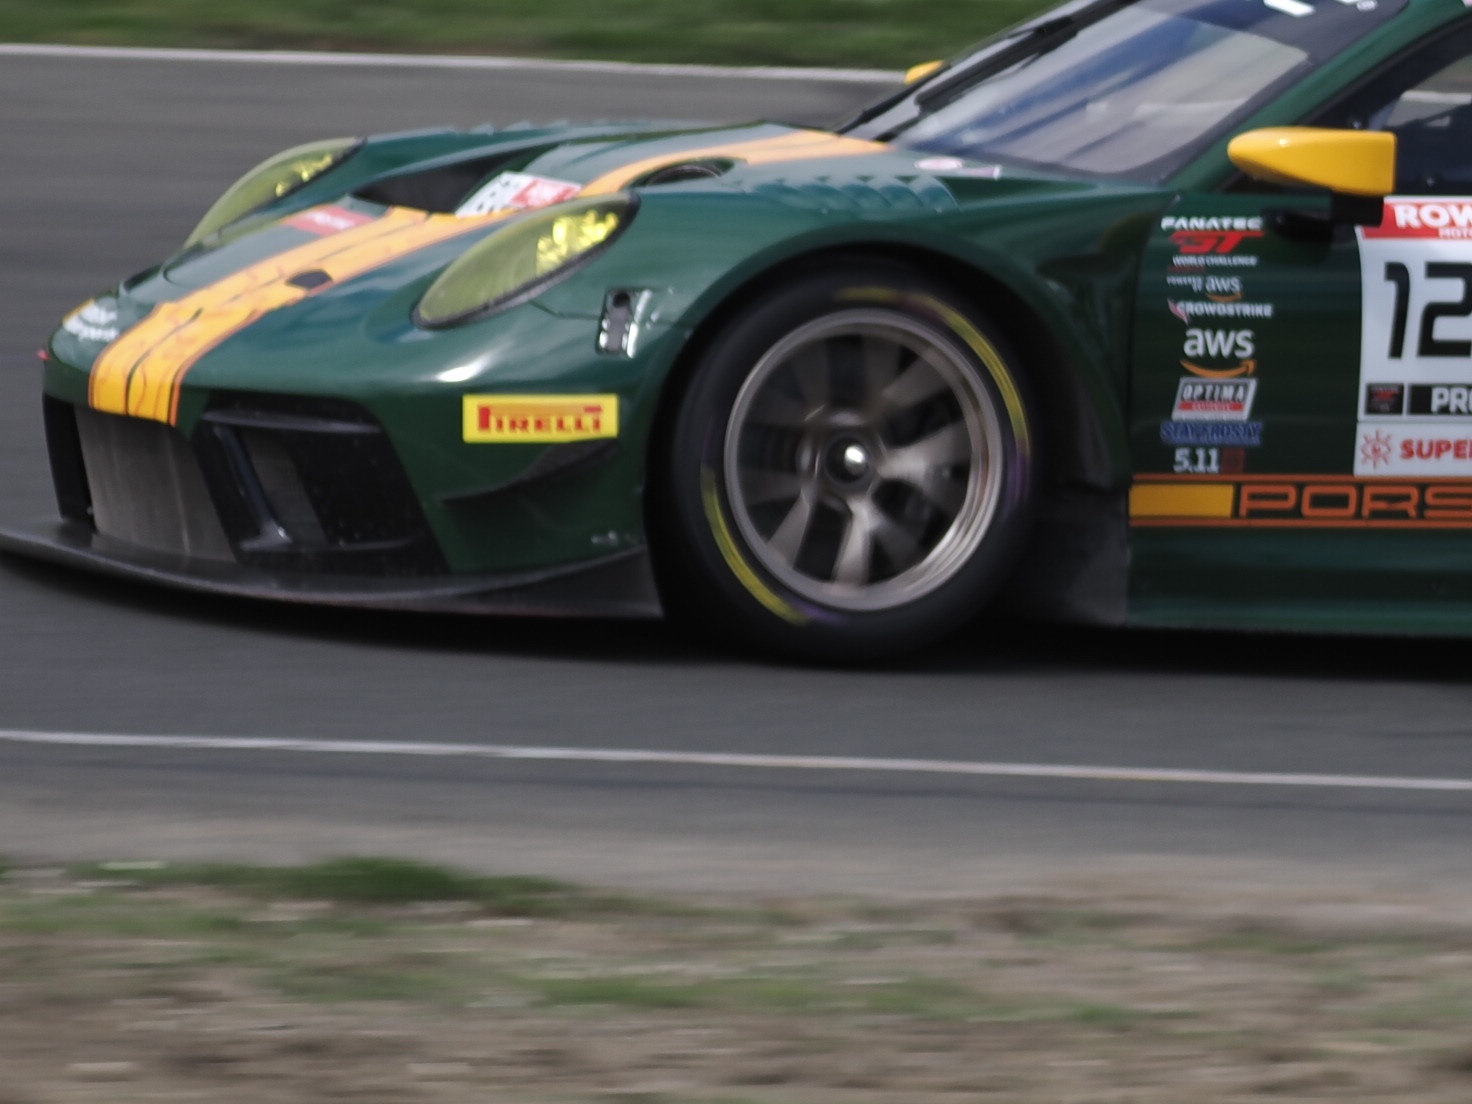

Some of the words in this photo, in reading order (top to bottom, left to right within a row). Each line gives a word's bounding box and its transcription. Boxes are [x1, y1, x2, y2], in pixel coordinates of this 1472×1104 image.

[1161, 216, 1263, 231] FANATEC
[1205, 275, 1242, 293] aws
[1176, 300, 1274, 318] CROWDSTRIKE
[1183, 327, 1255, 358] aws
[1182, 383, 1246, 401] OPTIMA
[478, 405, 602, 433] PIRELLI
[1173, 447, 1220, 474] 5.11
